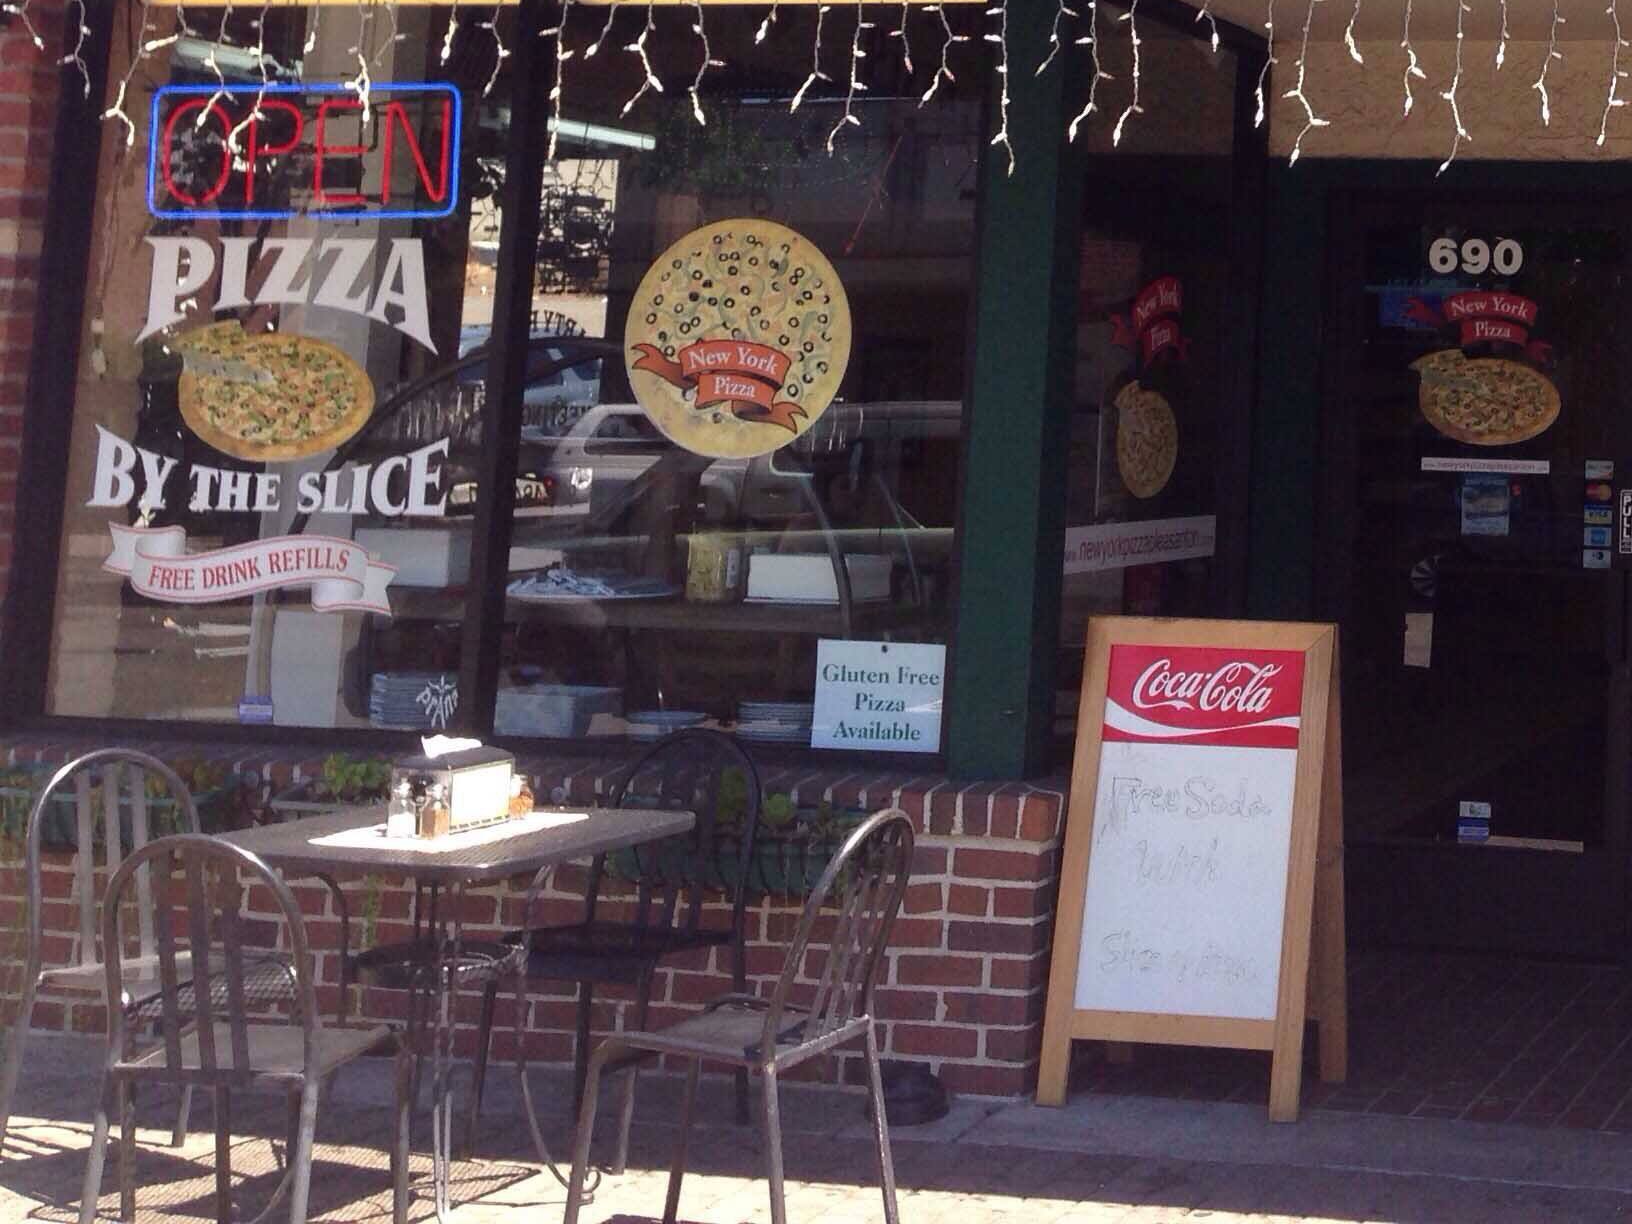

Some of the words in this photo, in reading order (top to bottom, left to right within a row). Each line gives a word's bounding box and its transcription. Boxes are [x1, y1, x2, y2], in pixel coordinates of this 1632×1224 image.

[161, 98, 452, 206] OPEN
[1428, 237, 1524, 276] 690
[135, 236, 439, 356] PIZZA
[1450, 299, 1487, 317] New
[1492, 296, 1529, 319] York
[1474, 321, 1512, 339] Pizza
[688, 349, 732, 371] New
[735, 347, 779, 376] York
[713, 376, 757, 399] Pizza
[85, 424, 180, 510] BY
[188, 465, 281, 512] THE
[297, 437, 450, 517] SLICE
[148, 564, 196, 591] FREE
[202, 556, 261, 590] DRINK
[269, 547, 350, 575] REFILLS
[822, 663, 890, 684] Gluten
[897, 665, 940, 686] Free
[1132, 658, 1283, 714] Coca-Cola
[854, 692, 906, 712] Pizza
[832, 720, 921, 741] Available
[1111, 776, 1181, 817] Free
[1183, 776, 1274, 821] Soda
